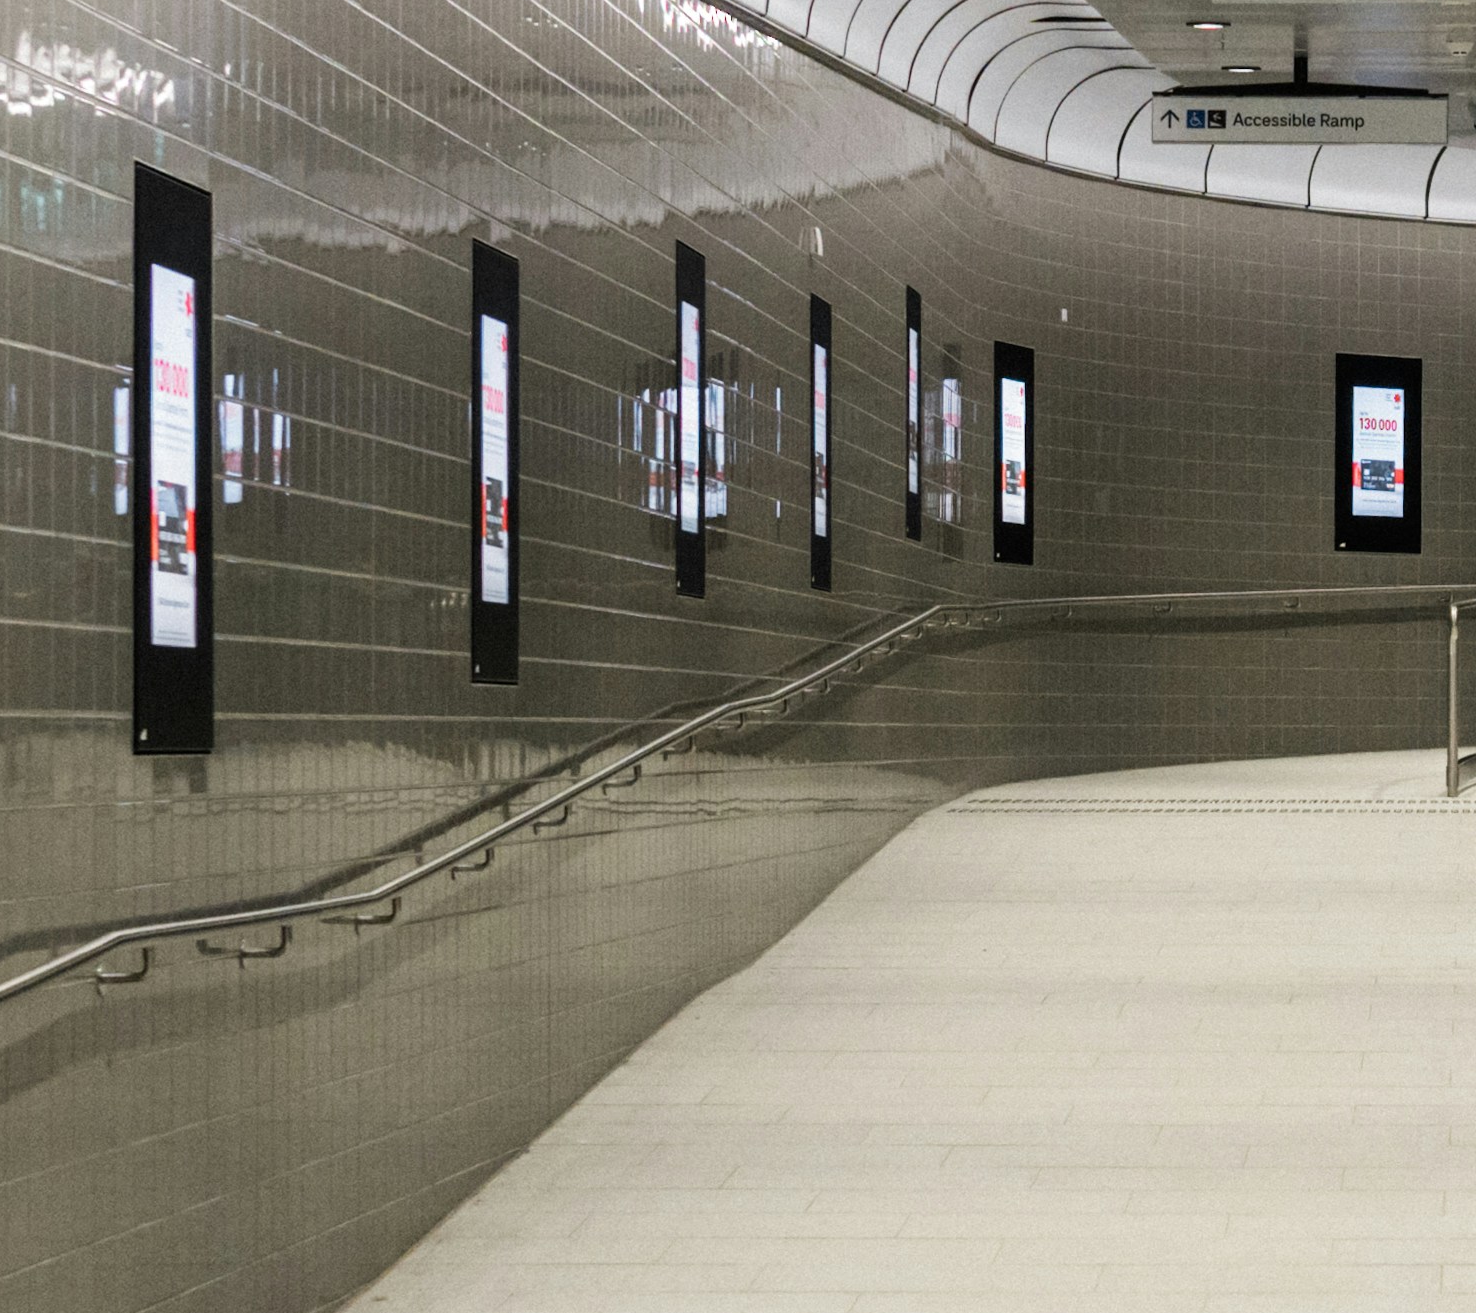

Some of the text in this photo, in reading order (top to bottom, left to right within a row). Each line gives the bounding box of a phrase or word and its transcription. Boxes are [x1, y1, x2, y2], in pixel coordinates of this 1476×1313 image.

[1232, 110, 1366, 132] Accessible Ramp
[1359, 417, 1398, 432] 130 000
